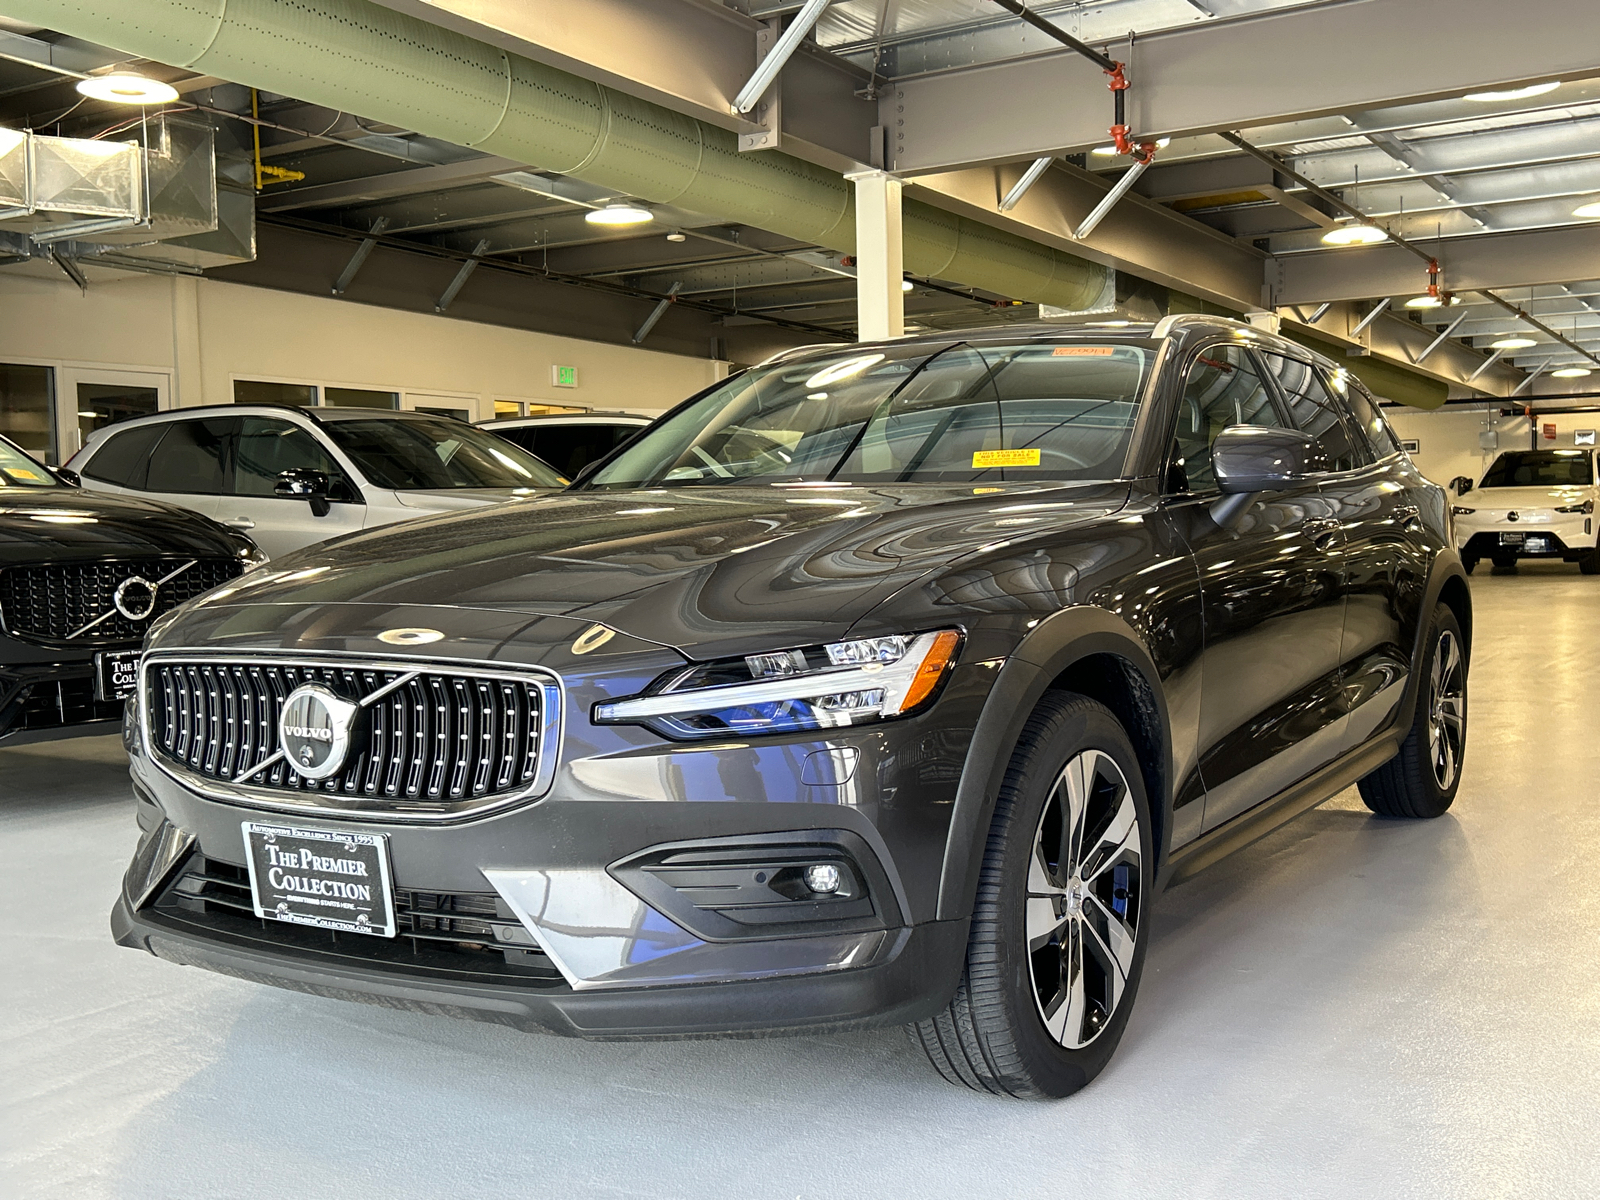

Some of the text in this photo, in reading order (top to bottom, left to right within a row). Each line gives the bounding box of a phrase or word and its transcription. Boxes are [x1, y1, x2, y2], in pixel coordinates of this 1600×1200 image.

[559, 366, 575, 385] EXIT
[112, 661, 133, 673] THE
[284, 725, 332, 739] VOLVO
[354, 835, 374, 845] 1995
[265, 844, 368, 876] THE PREMIER
[268, 867, 371, 901] COLLECTION
